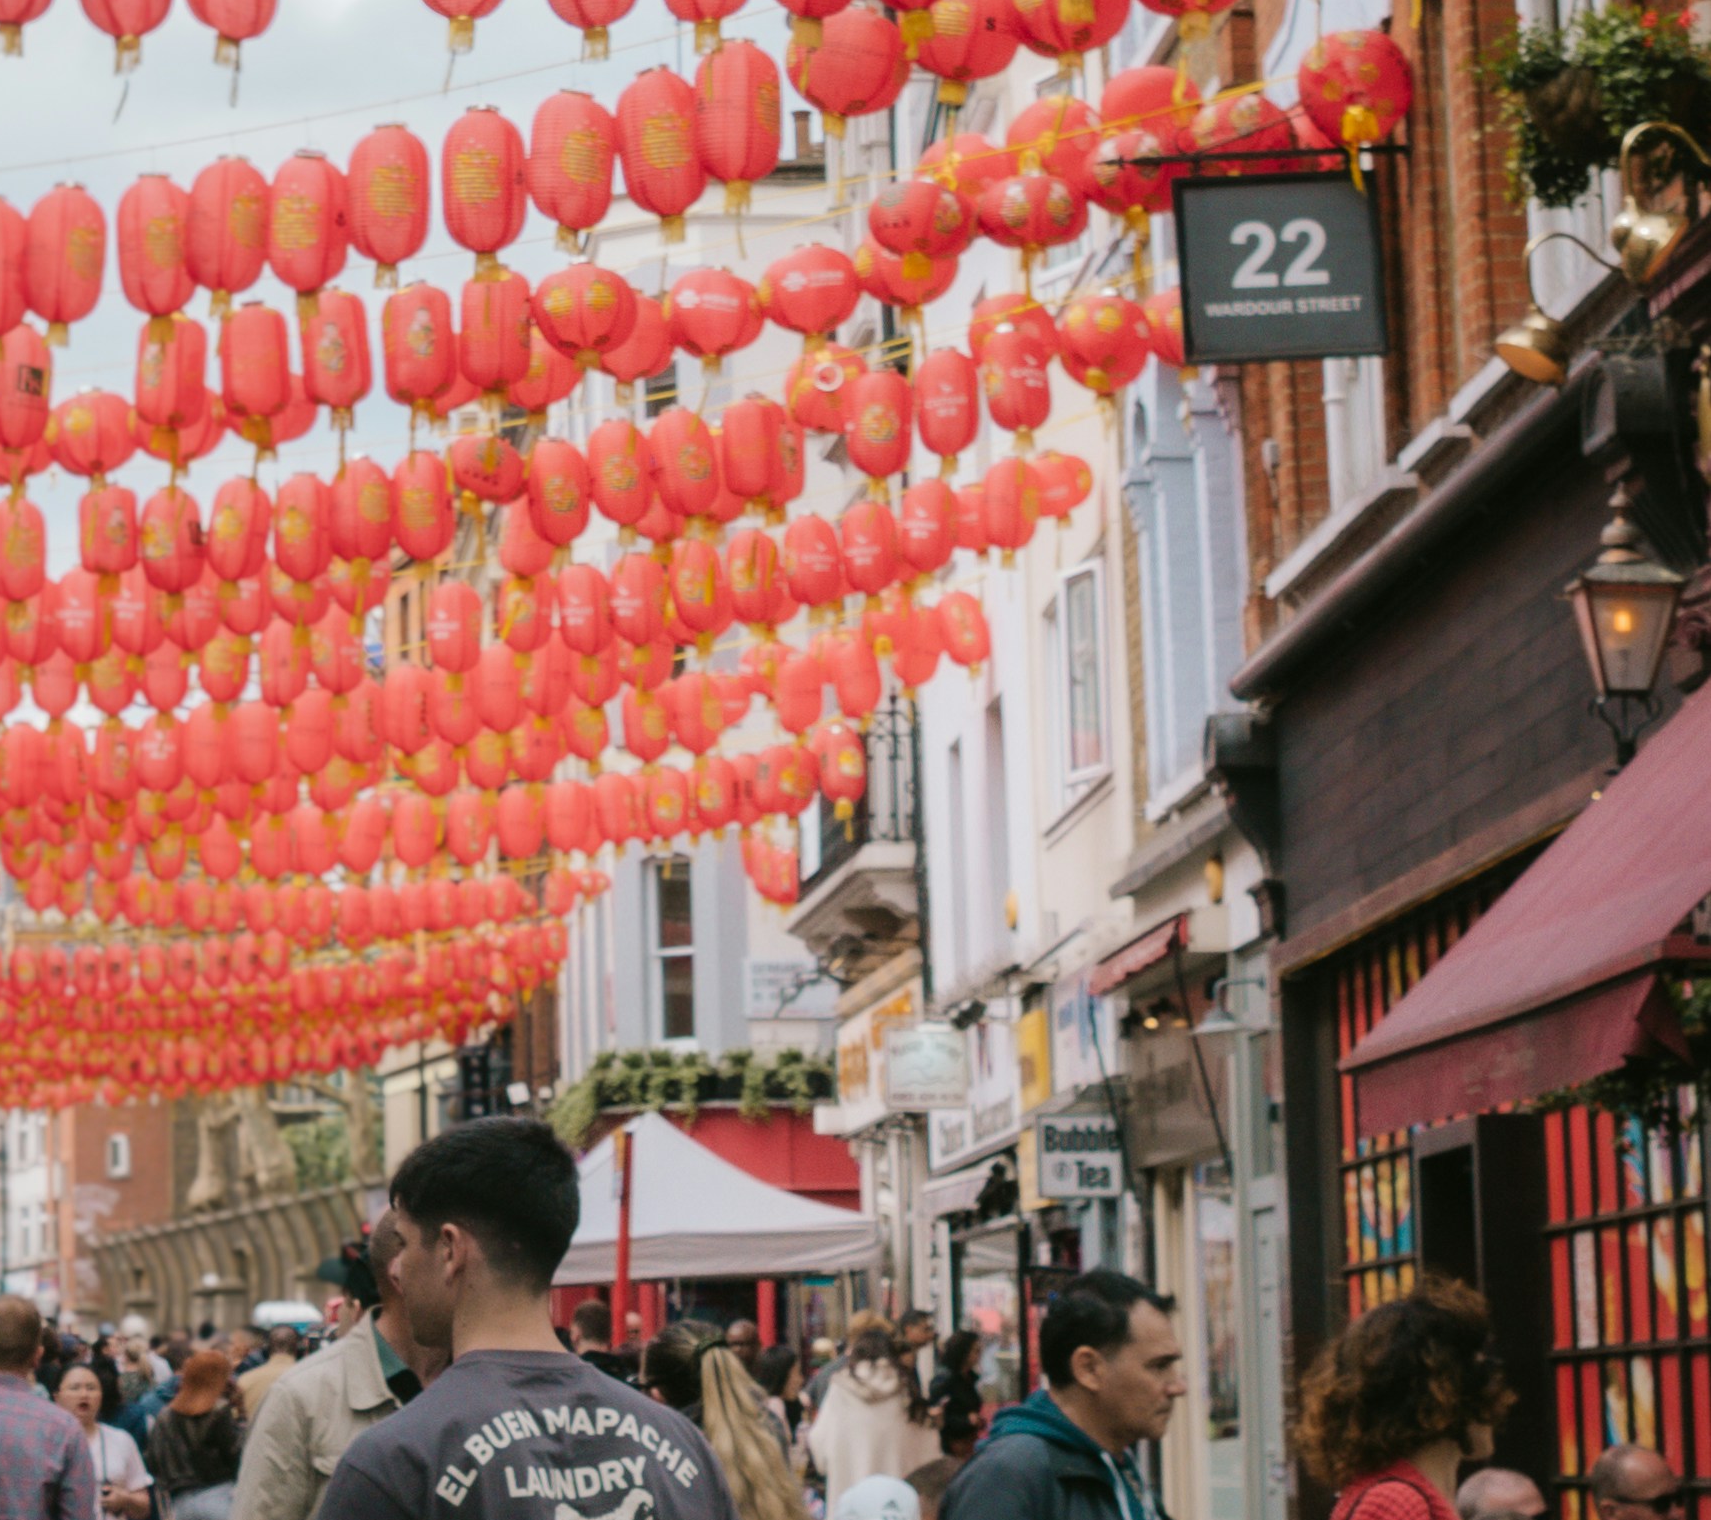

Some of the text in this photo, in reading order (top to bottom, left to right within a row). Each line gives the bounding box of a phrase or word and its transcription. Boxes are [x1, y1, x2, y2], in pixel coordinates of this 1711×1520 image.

[1230, 217, 1330, 289] 22
[1204, 295, 1362, 317] WARDOUR STREET
[1075, 1160, 1110, 1188] Tea
[435, 1405, 699, 1507] EL BUEN MAPACHE
[504, 1455, 647, 1500] LAUNDRY
